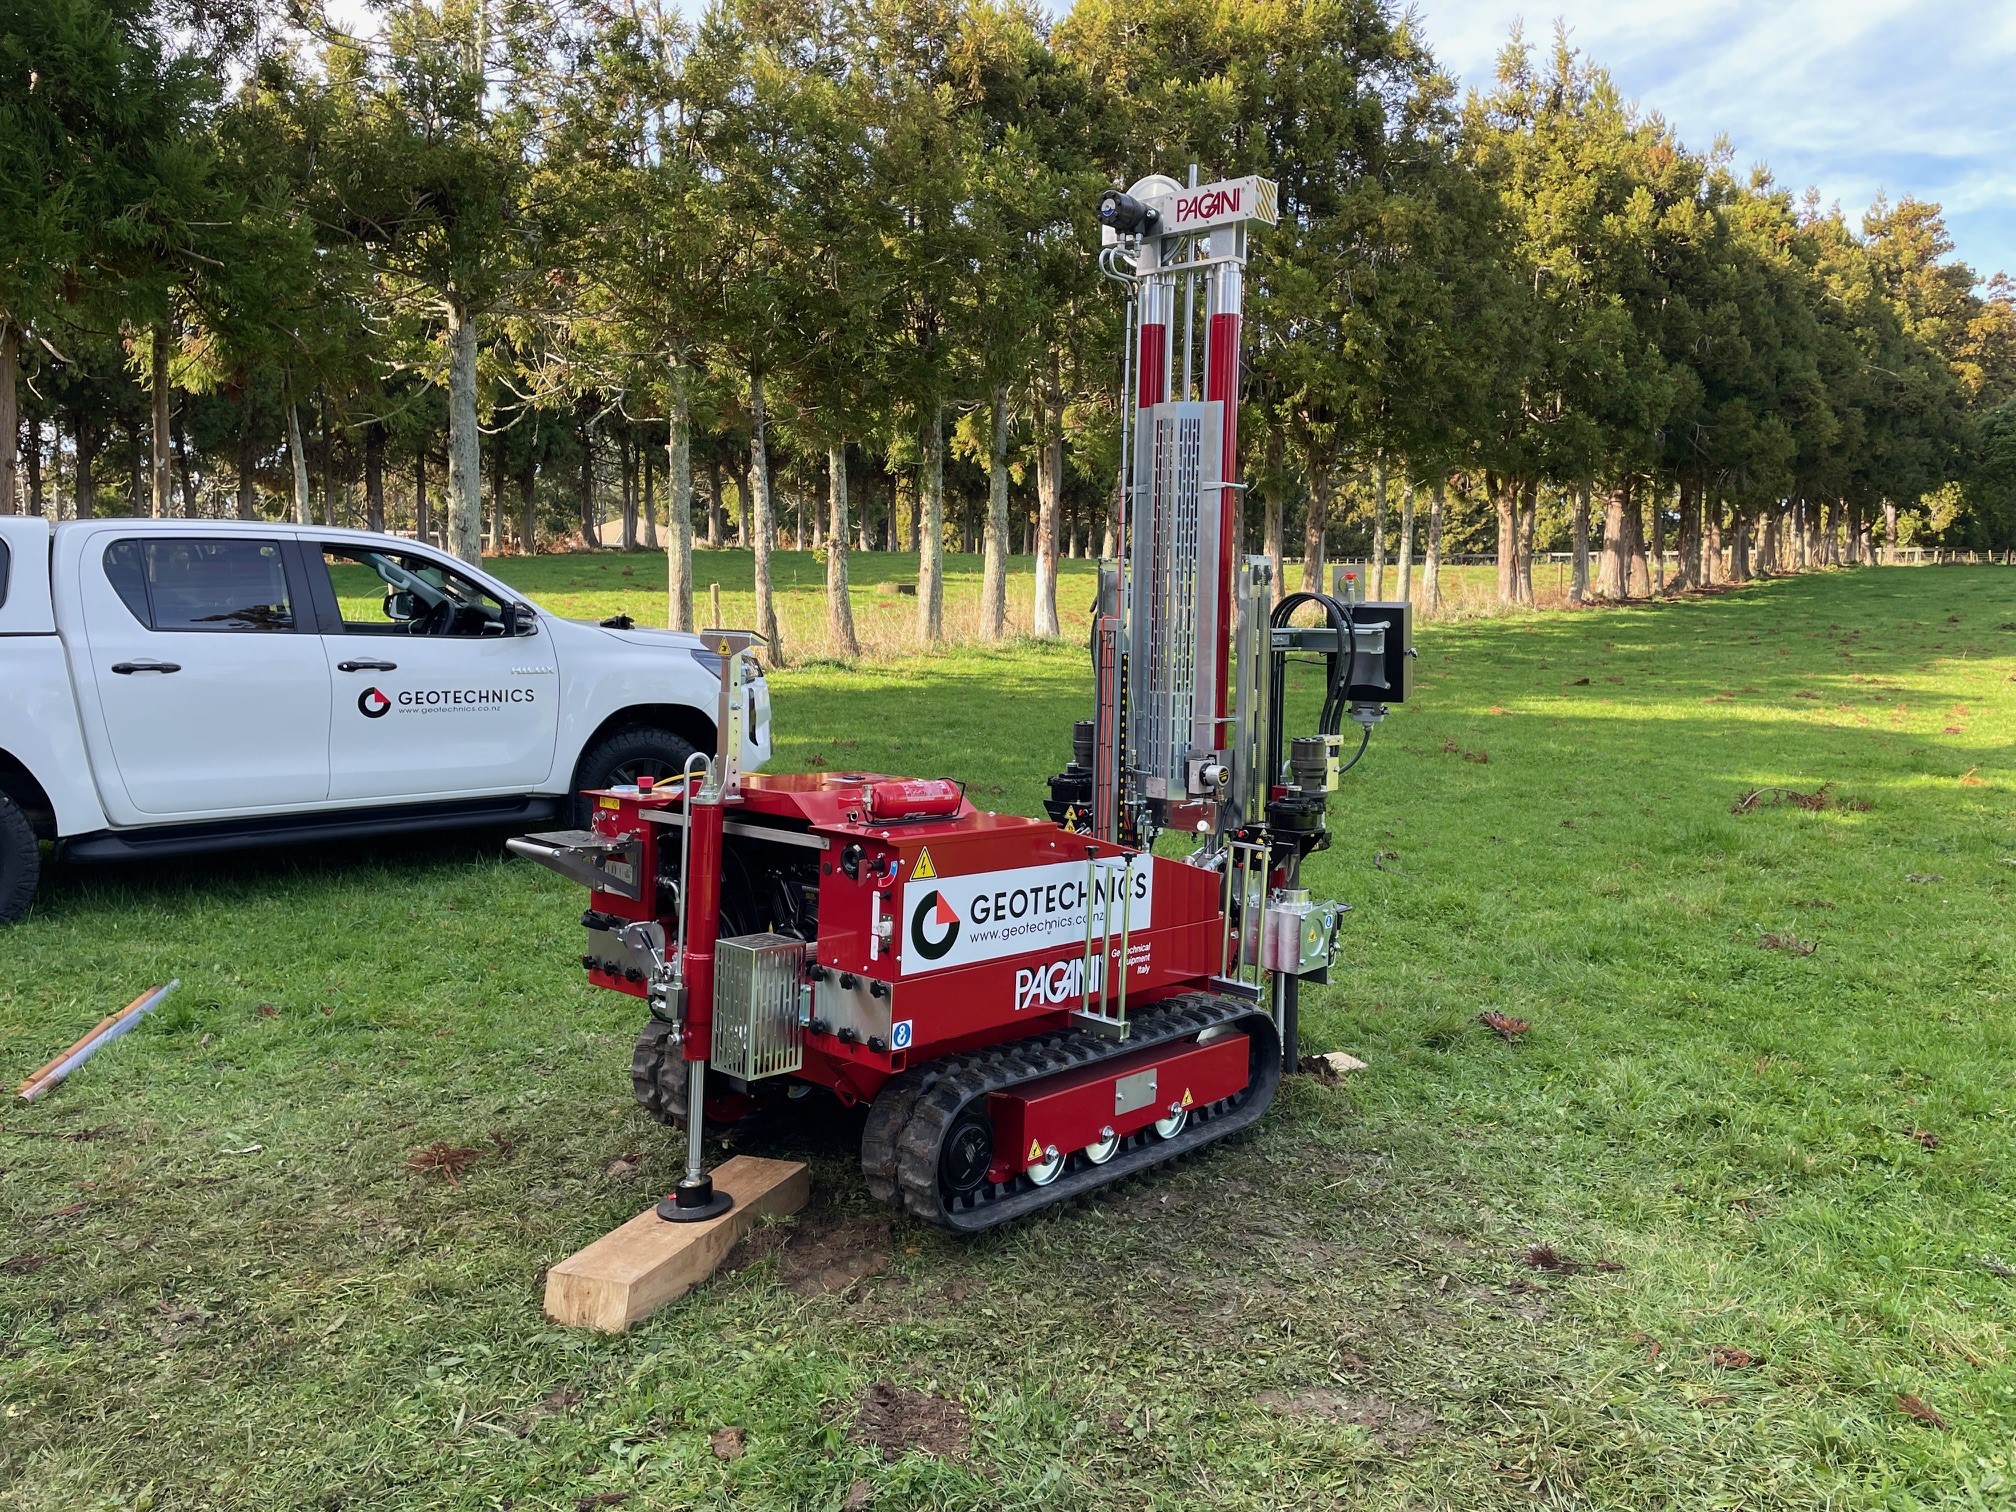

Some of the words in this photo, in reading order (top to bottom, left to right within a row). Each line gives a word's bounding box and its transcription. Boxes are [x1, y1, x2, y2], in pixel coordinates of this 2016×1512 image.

[1176, 187, 1241, 223] PAGANI
[398, 689, 535, 705] GEOTECHNICS
[398, 705, 501, 715] www.geotechnics.co.nz
[970, 872, 1147, 925] GEOTECHNICS
[970, 912, 1104, 943] www.geotechnics.cnz
[1111, 942, 1151, 958] Gechnical
[1118, 953, 1151, 967] uipment
[1014, 954, 1100, 1011] PAGANI
